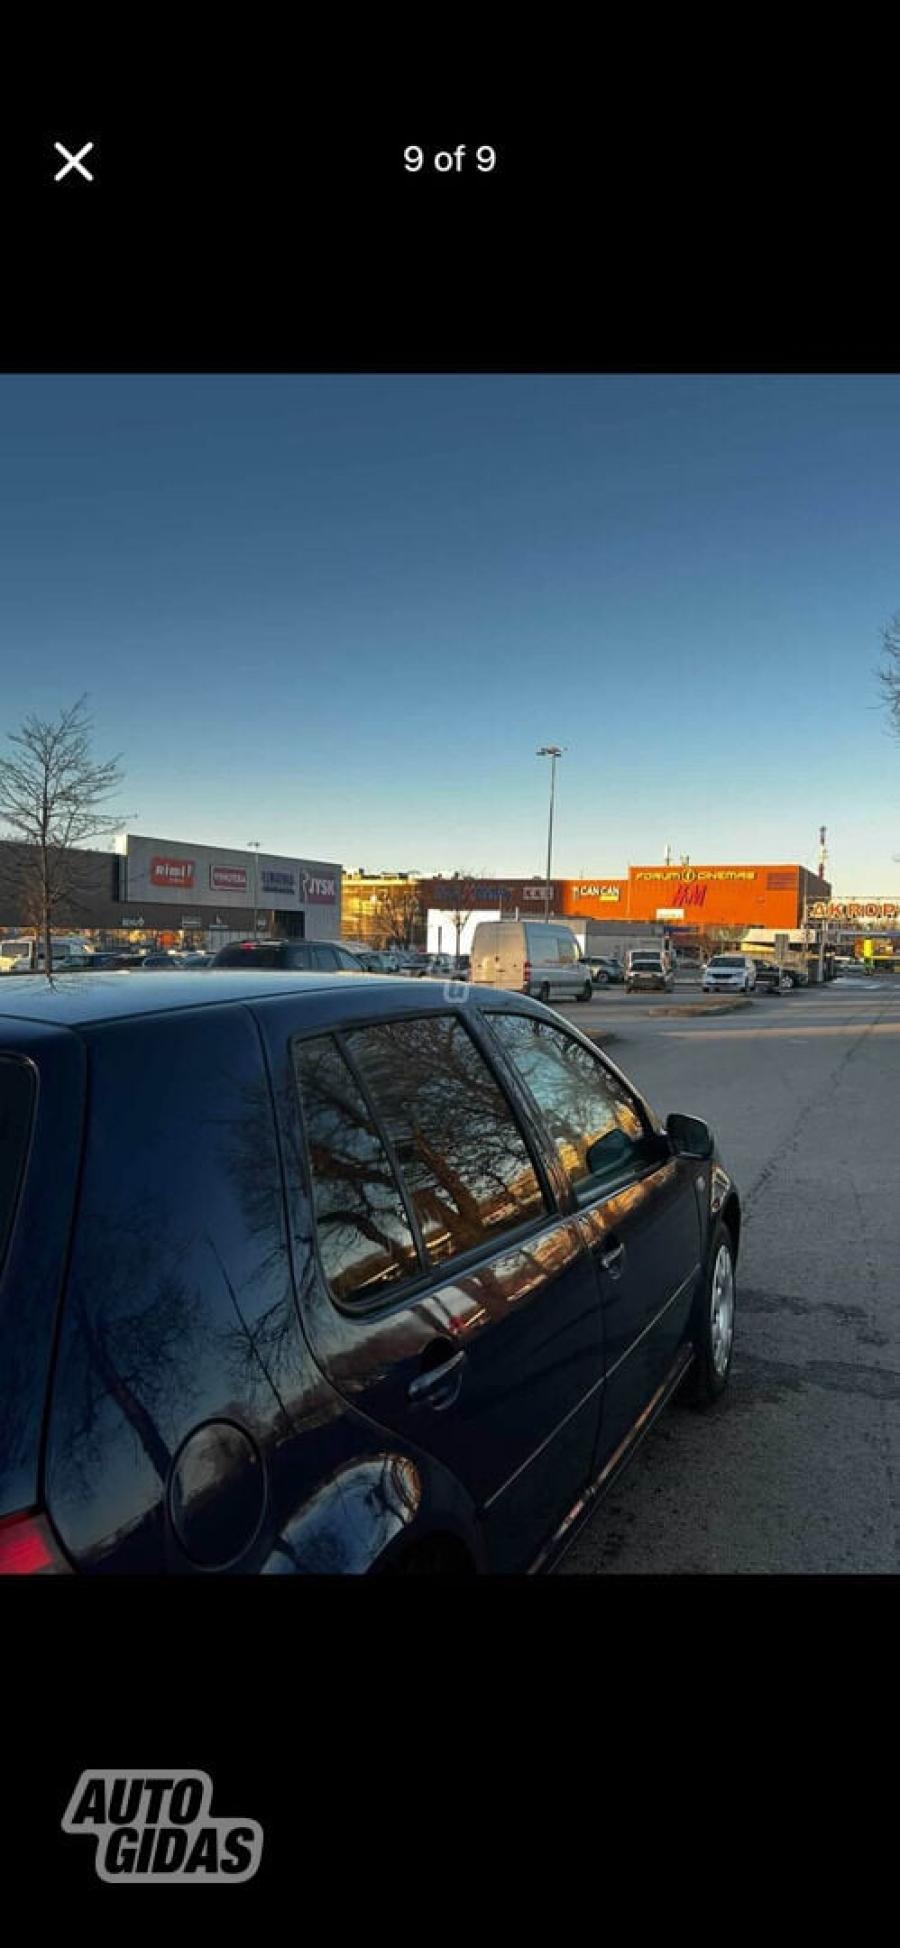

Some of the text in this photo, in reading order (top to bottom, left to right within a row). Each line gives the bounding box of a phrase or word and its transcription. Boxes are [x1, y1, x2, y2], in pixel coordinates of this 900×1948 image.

[308, 878, 336, 897] JYSK
[580, 885, 619, 897] CAN CAN
[810, 902, 900, 919] AKROP
